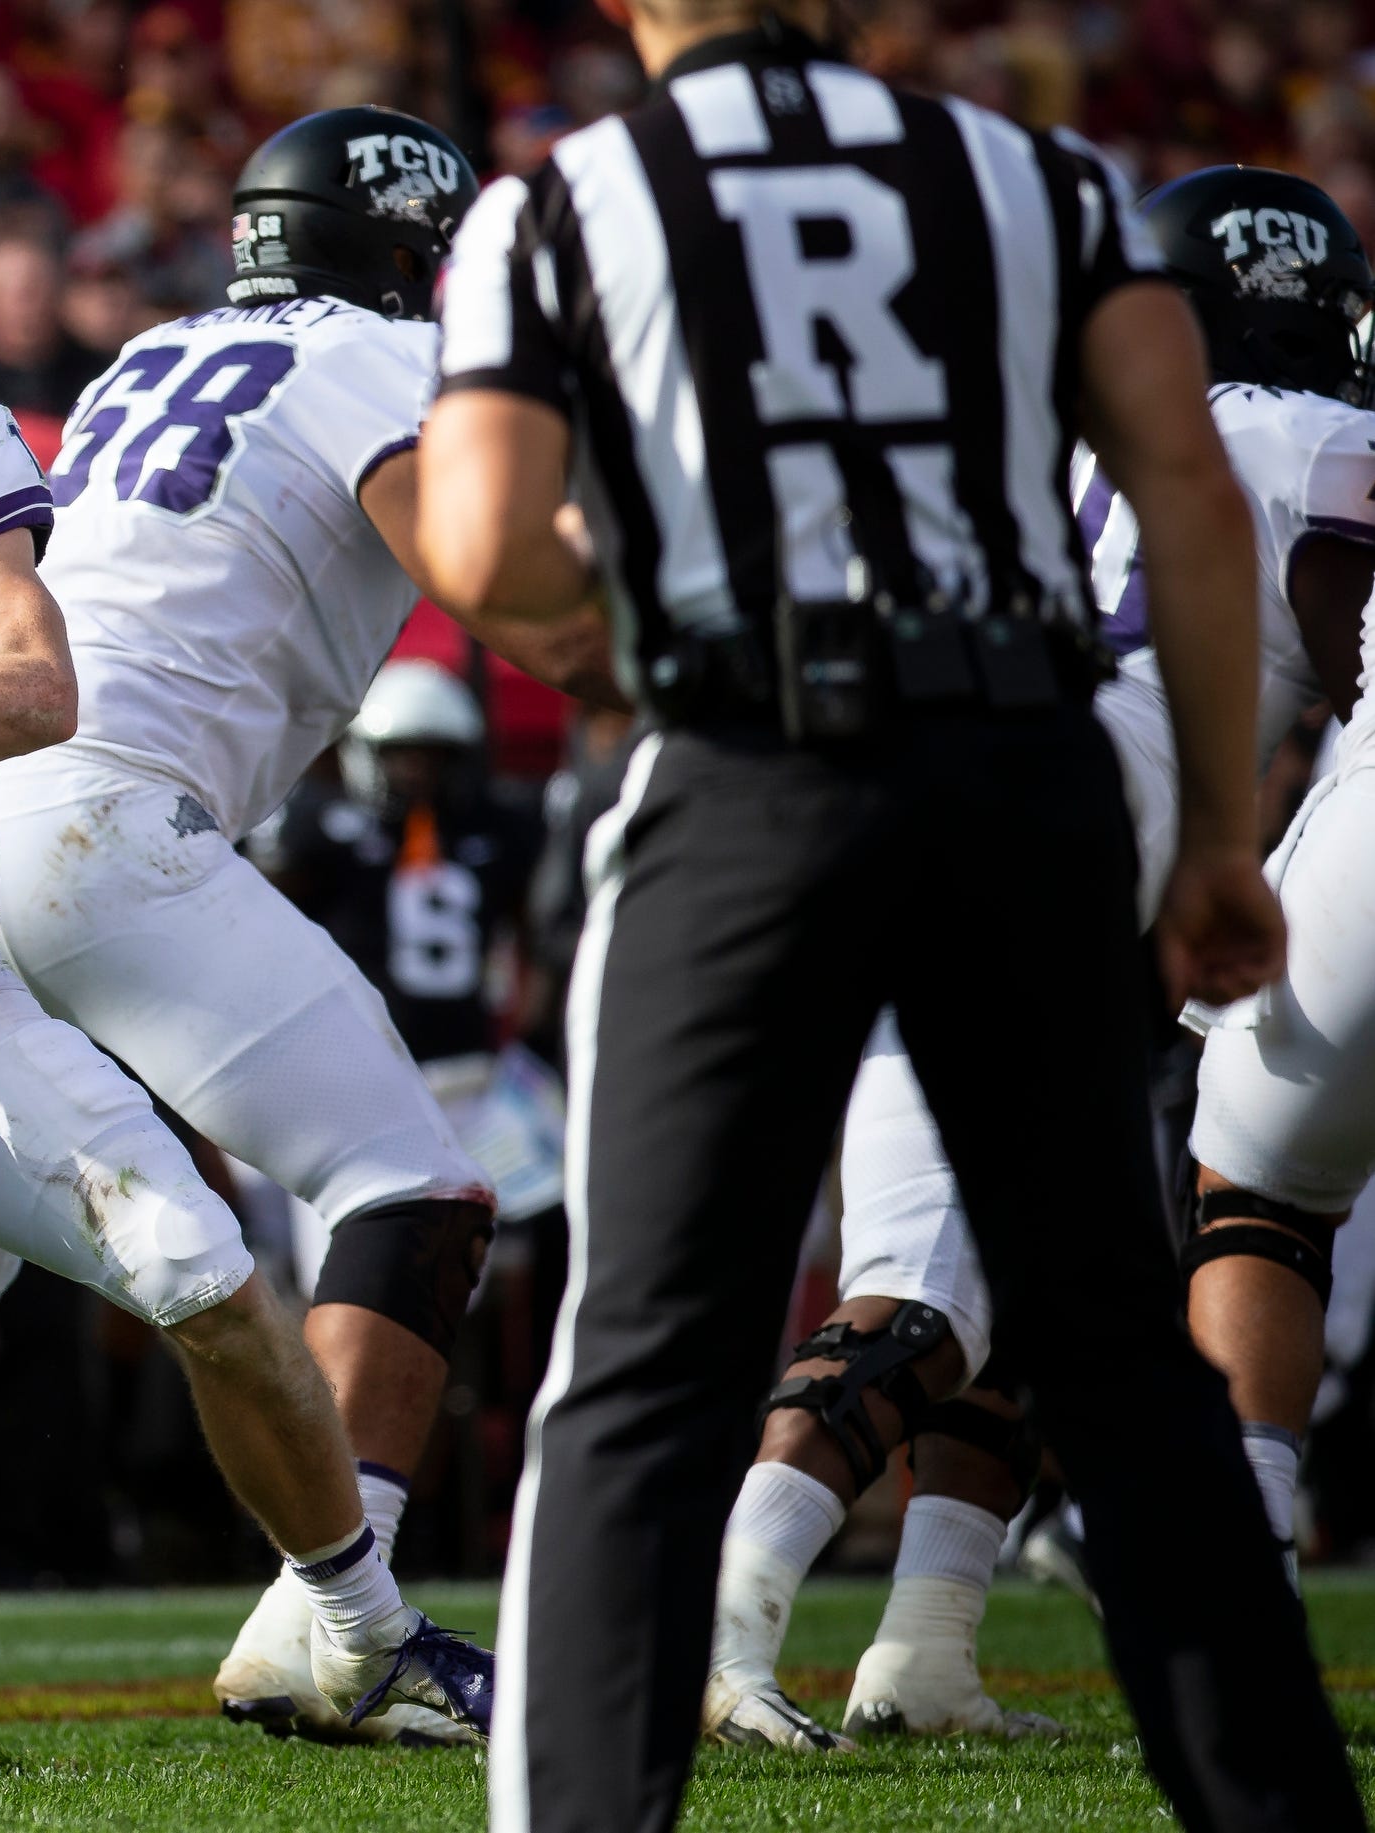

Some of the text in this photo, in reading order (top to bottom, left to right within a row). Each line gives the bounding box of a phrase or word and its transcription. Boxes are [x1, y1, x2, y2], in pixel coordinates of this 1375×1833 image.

[347, 134, 459, 194] TCU
[709, 164, 947, 424] R
[1210, 207, 1328, 266] TCU
[49, 341, 299, 515] 68
